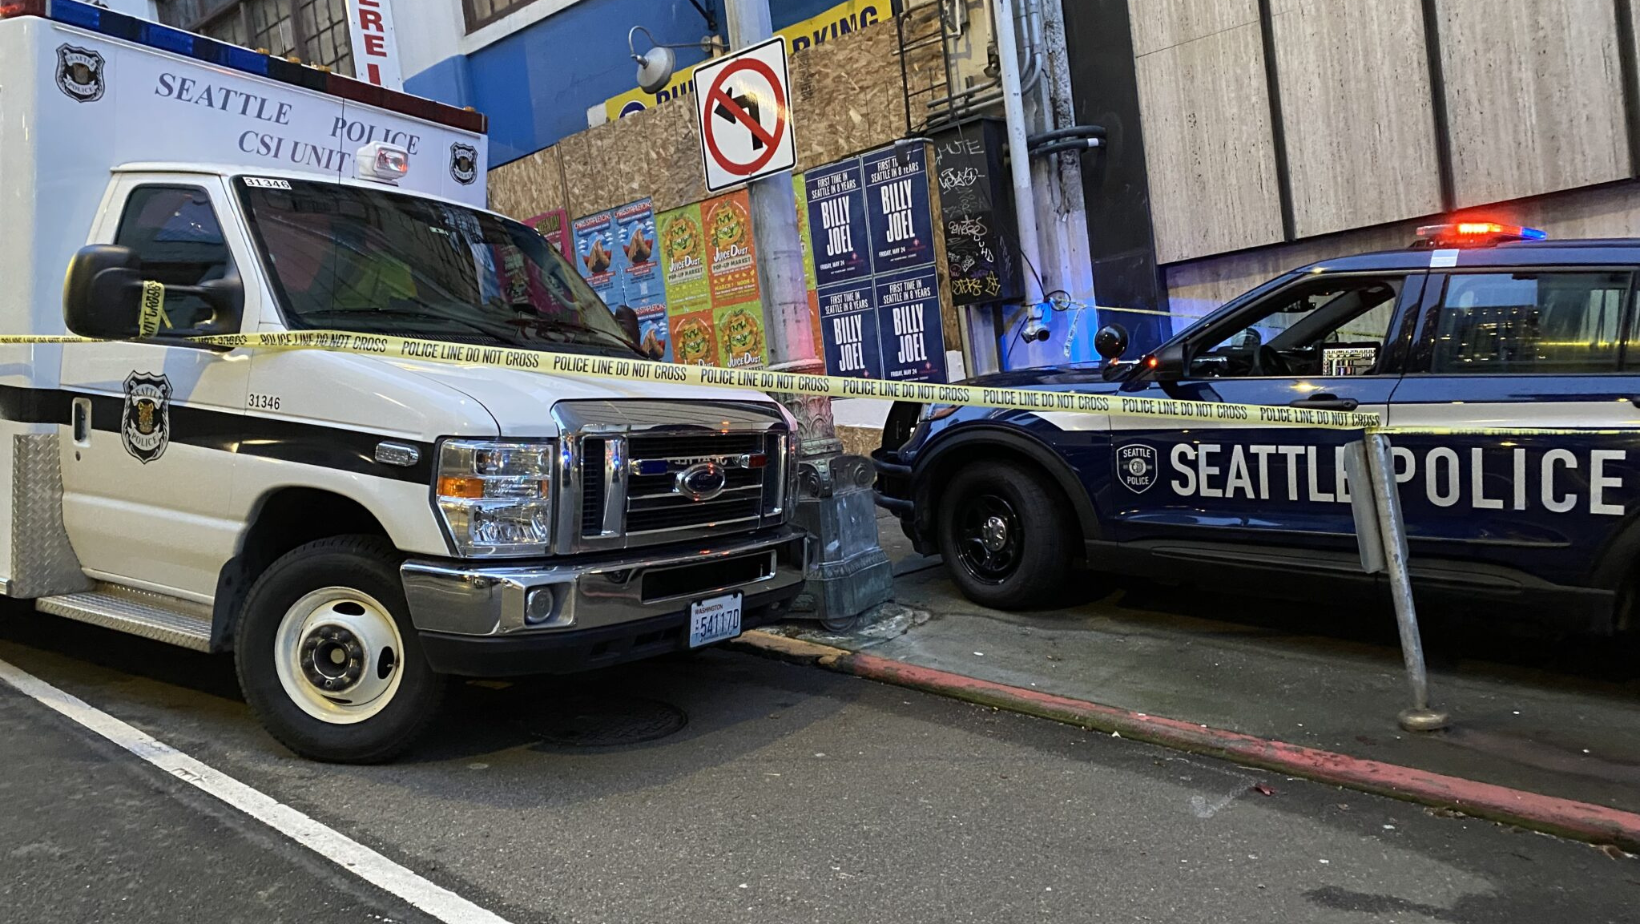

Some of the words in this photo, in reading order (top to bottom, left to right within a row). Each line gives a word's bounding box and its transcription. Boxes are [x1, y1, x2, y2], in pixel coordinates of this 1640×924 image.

[154, 73, 292, 125] SEATTLE
[329, 116, 420, 156] POLICE
[238, 130, 285, 159] CSI
[290, 140, 351, 172] UNIT
[871, 169, 891, 183] SEATTLE
[891, 167, 898, 177] IN
[877, 158, 891, 172] FIRST
[245, 177, 290, 189] 31346
[811, 184, 831, 199] SEATTLE
[831, 183, 837, 194] IN
[836, 182, 841, 193] 8
[841, 179, 857, 191] YEARS
[817, 176, 830, 188] FIRST
[831, 173, 842, 185] TIME
[842, 172, 848, 181] IN
[880, 179, 912, 214] BILLY
[820, 195, 850, 230] BILLY
[886, 209, 915, 243] JOEL
[827, 224, 854, 257] JOEL
[713, 261, 730, 271] POP-UP
[731, 256, 751, 266] MARKET
[883, 292, 903, 304] SEATTLE
[903, 291, 909, 300] IN
[909, 290, 914, 299] 8
[915, 287, 931, 299] YEARS
[889, 282, 903, 293] FIRST
[904, 280, 914, 290] TIME
[915, 279, 922, 288] IN
[825, 303, 843, 315] SEATTLE
[843, 302, 849, 311] IN
[853, 299, 868, 310] YEARS
[830, 292, 843, 304] FIRST
[844, 291, 854, 302] TIME
[855, 291, 860, 300] IN
[833, 314, 862, 345] BILLY
[892, 303, 924, 336] BILLY
[258, 333, 292, 346] POLICE
[294, 333, 313, 346] LINE
[314, 333, 329, 347] DO
[330, 334, 351, 348] NOT
[353, 335, 388, 353] CROSS
[898, 332, 927, 364] JOEL
[401, 341, 439, 358] POLICE
[440, 345, 465, 361] LINE
[466, 347, 481, 363] DO
[482, 349, 504, 365] NOT
[505, 351, 540, 368] CROSS
[838, 342, 865, 372] JOEL
[553, 356, 589, 373] POLICE
[592, 359, 614, 375] LINE
[616, 362, 629, 376] DO
[632, 363, 652, 378] NOT
[654, 364, 687, 381] CROSS
[700, 368, 735, 385] POLICE
[738, 371, 758, 387] LINE
[761, 373, 774, 388] DO
[776, 374, 796, 390] NOT
[798, 376, 830, 392] CROSS
[843, 379, 877, 396] POLICE
[880, 382, 900, 398] LINE
[902, 384, 915, 398] DO
[917, 385, 937, 400] NOT
[939, 386, 970, 403] CROSS
[983, 389, 1017, 405] POLICE
[1019, 392, 1039, 407] LINE
[1042, 393, 1054, 407] DO
[1057, 395, 1075, 409] NOT
[1078, 396, 1109, 411] CROSS
[249, 394, 280, 410] 31346
[1122, 398, 1156, 414] POLICE
[1158, 400, 1178, 416] LINE
[1180, 402, 1193, 416] DO
[1195, 403, 1213, 418] NOT
[1216, 404, 1248, 420] CROSS
[1260, 407, 1292, 423] POLICE
[1294, 409, 1315, 424] LINE
[1317, 410, 1329, 425] DO
[1331, 412, 1349, 426] NOT
[1351, 413, 1380, 427] CROSS
[131, 433, 157, 448] POLICE
[1123, 448, 1151, 458] SEATTLE
[1127, 476, 1149, 485] POLICE
[1170, 443, 1352, 503] SEATTLE
[1391, 447, 1626, 516] POLICE
[695, 603, 724, 615] WASHINGTON
